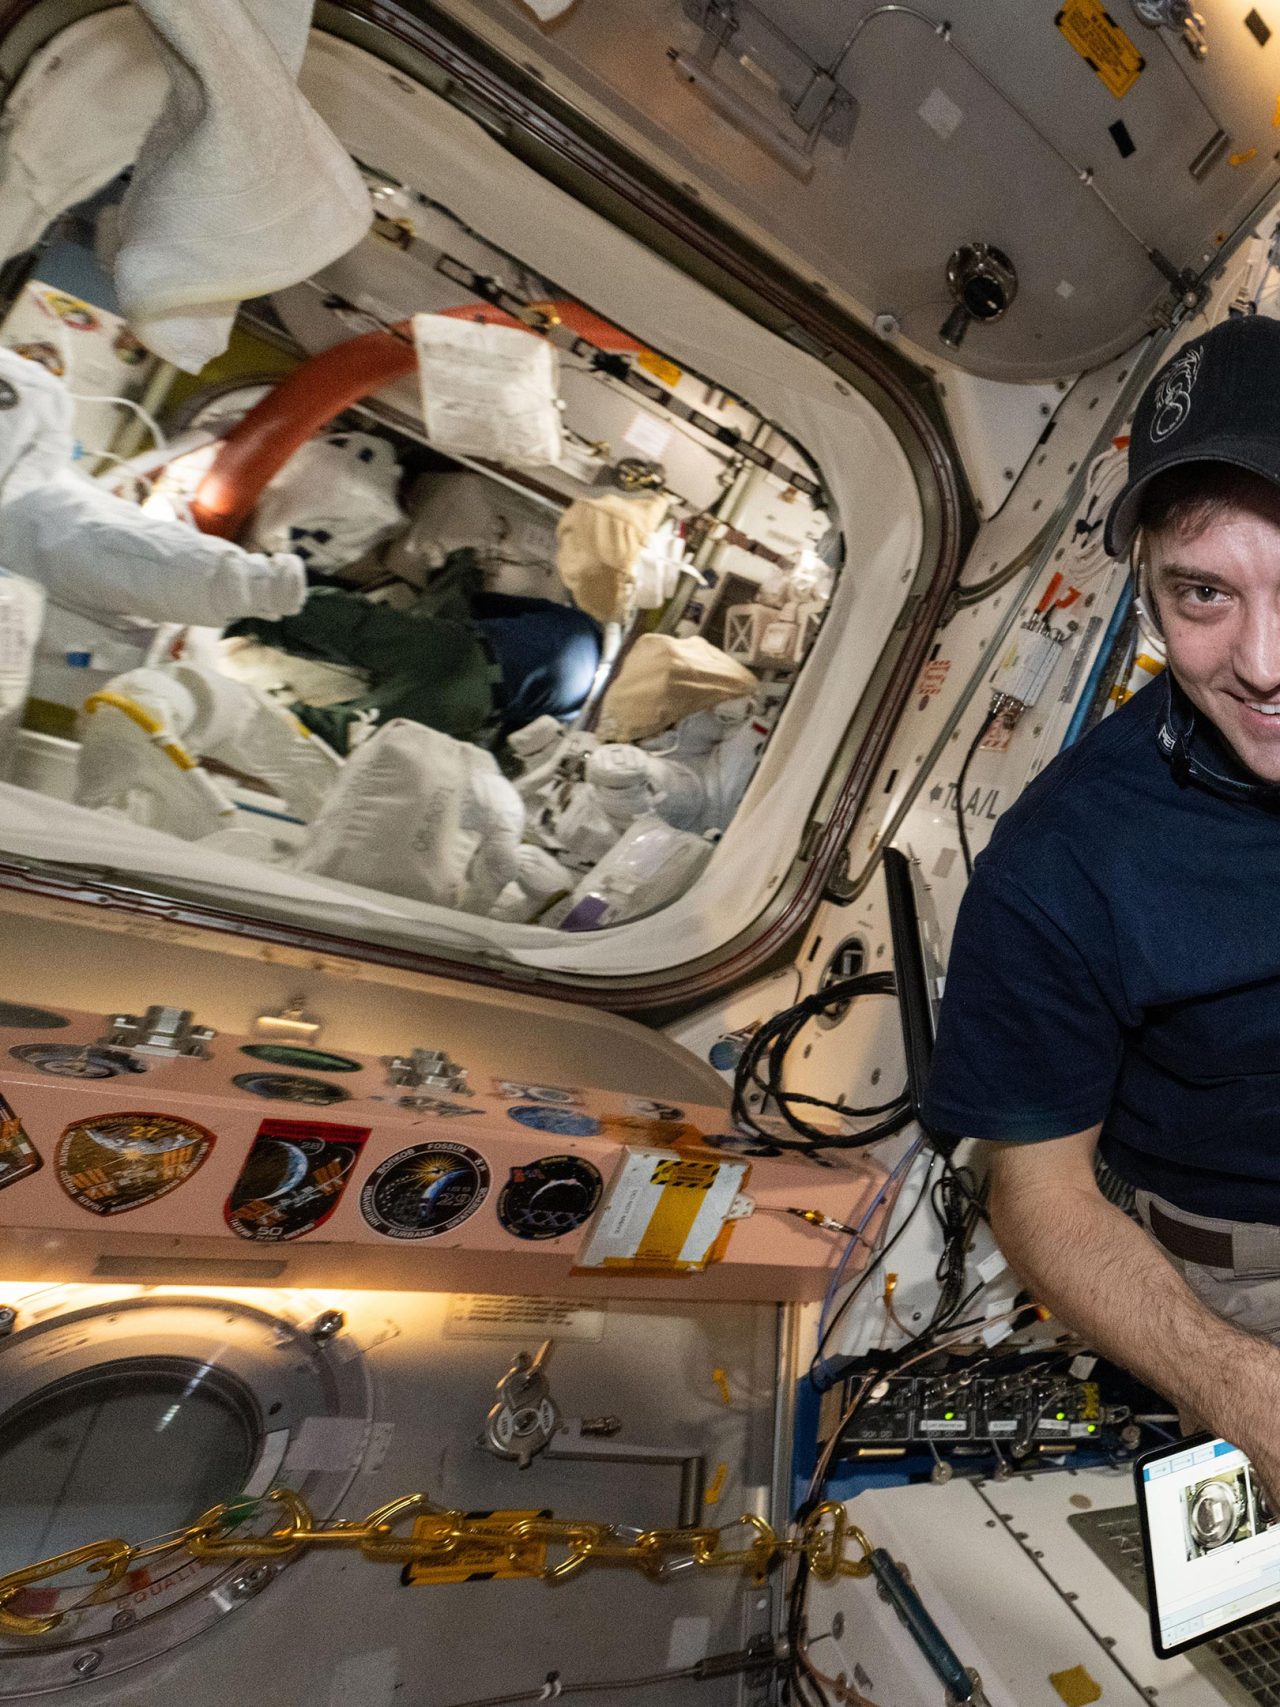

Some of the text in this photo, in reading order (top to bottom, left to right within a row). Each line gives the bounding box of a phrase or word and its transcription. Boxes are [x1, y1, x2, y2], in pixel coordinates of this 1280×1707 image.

[963, 786, 999, 819] A/L
[128, 1126, 160, 1137] 27
[300, 1141, 321, 1150] 28
[427, 1143, 468, 1153] FOSSUM
[436, 1193, 472, 1206] 29
[256, 1226, 284, 1236] 50
[387, 1228, 435, 1238] BURBANK
[116, 1564, 198, 1610] EQUALI
